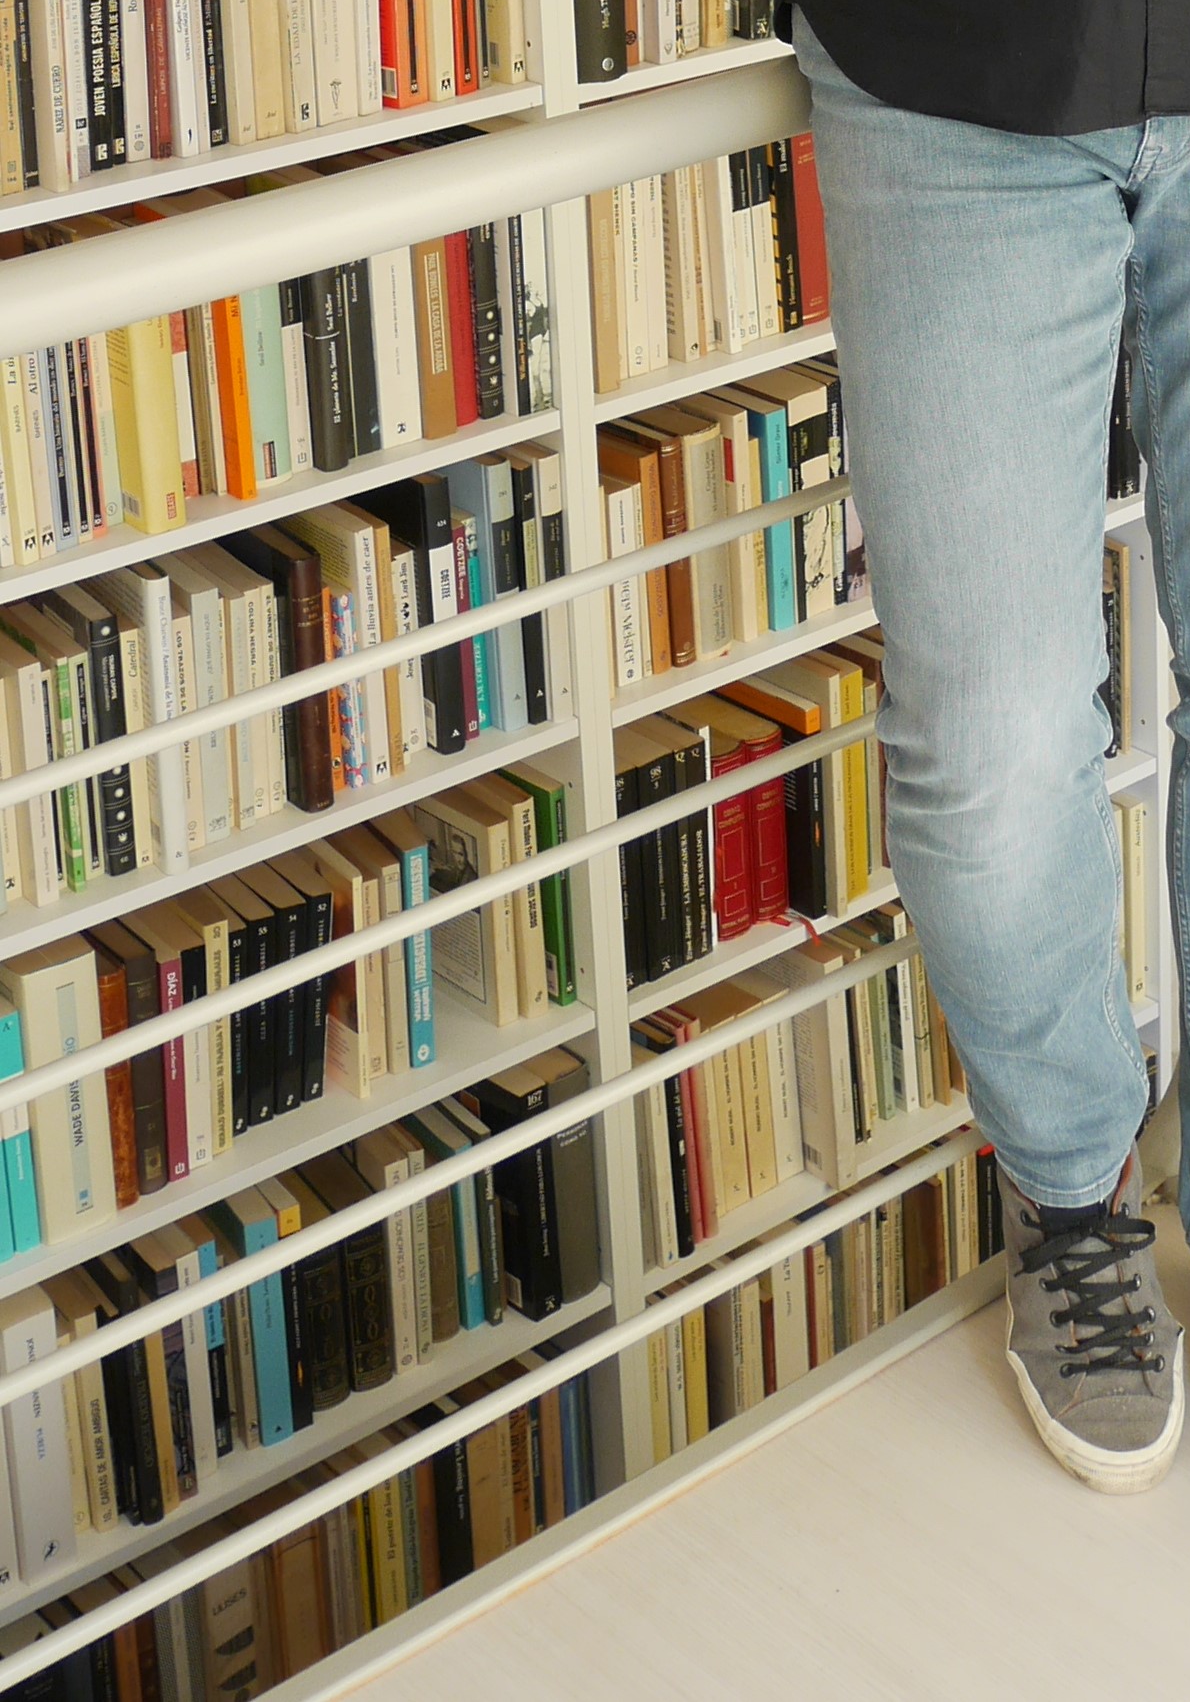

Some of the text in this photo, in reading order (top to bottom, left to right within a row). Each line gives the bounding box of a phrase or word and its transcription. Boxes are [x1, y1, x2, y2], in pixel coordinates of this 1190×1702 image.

[109, 13, 119, 23] DE
[290, 7, 299, 19] DE
[108, 26, 120, 64] ESPAÑOLA
[291, 22, 301, 49] EDAD
[51, 65, 65, 133] NARIZ DE CUERO
[92, 86, 106, 116] JOVEN
[7, 371, 16, 384] La
[27, 359, 37, 380] otro
[28, 383, 38, 395] Al
[361, 537, 377, 645] La lluvia antes de caer
[127, 640, 138, 677] Catedral
[71, 1113, 84, 1146] WADE
